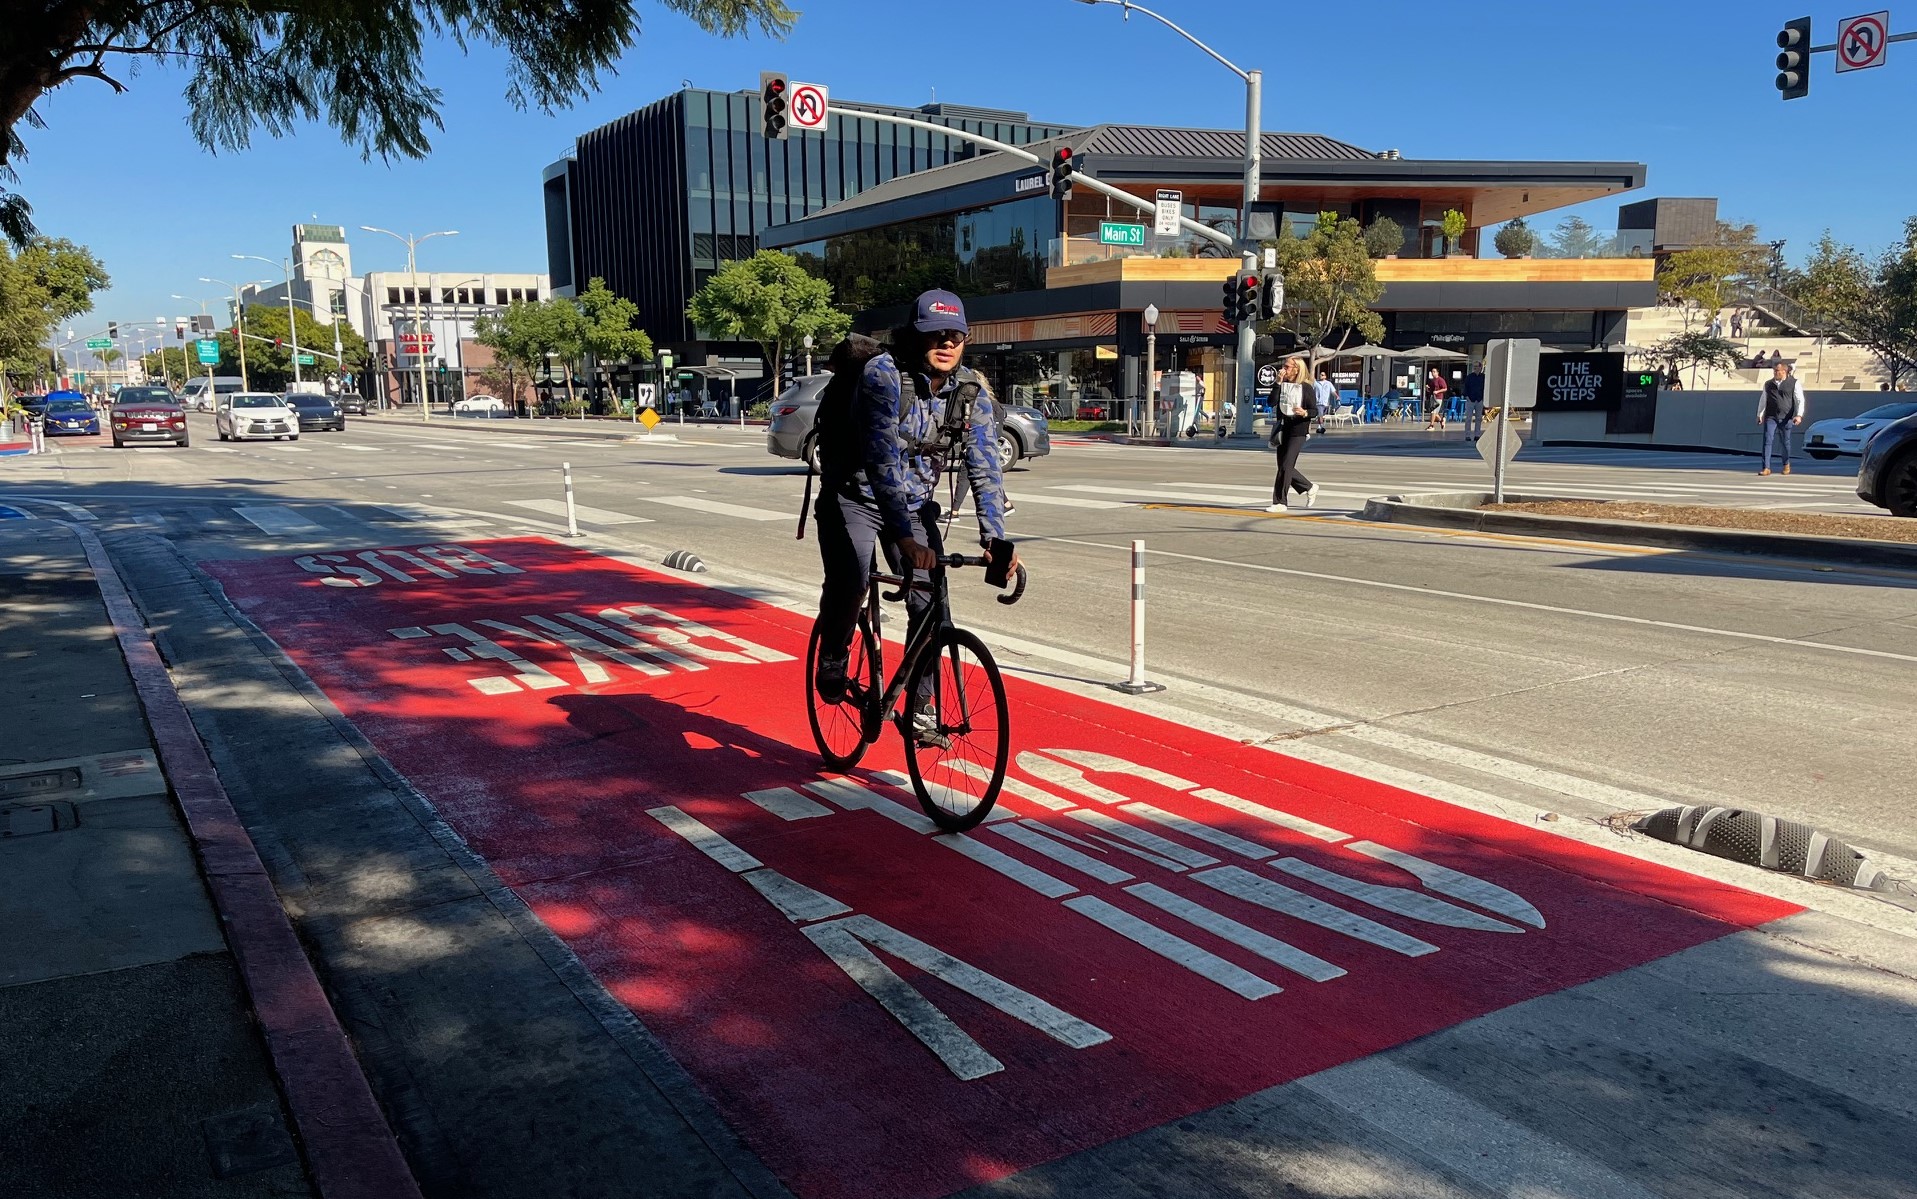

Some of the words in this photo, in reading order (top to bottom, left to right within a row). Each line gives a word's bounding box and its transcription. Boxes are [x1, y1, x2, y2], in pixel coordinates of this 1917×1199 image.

[1015, 176, 1044, 193] LAUREL
[1104, 226, 1128, 241] Main
[1130, 227, 1141, 243] St
[1562, 362, 1590, 375] THE
[1547, 375, 1603, 388] CULVER
[1640, 375, 1652, 385] 54
[1552, 388, 1596, 401] STEPS
[294, 545, 527, 588] BUS
[387, 605, 798, 696] BIKE
[645, 748, 1546, 1081] ONLY
